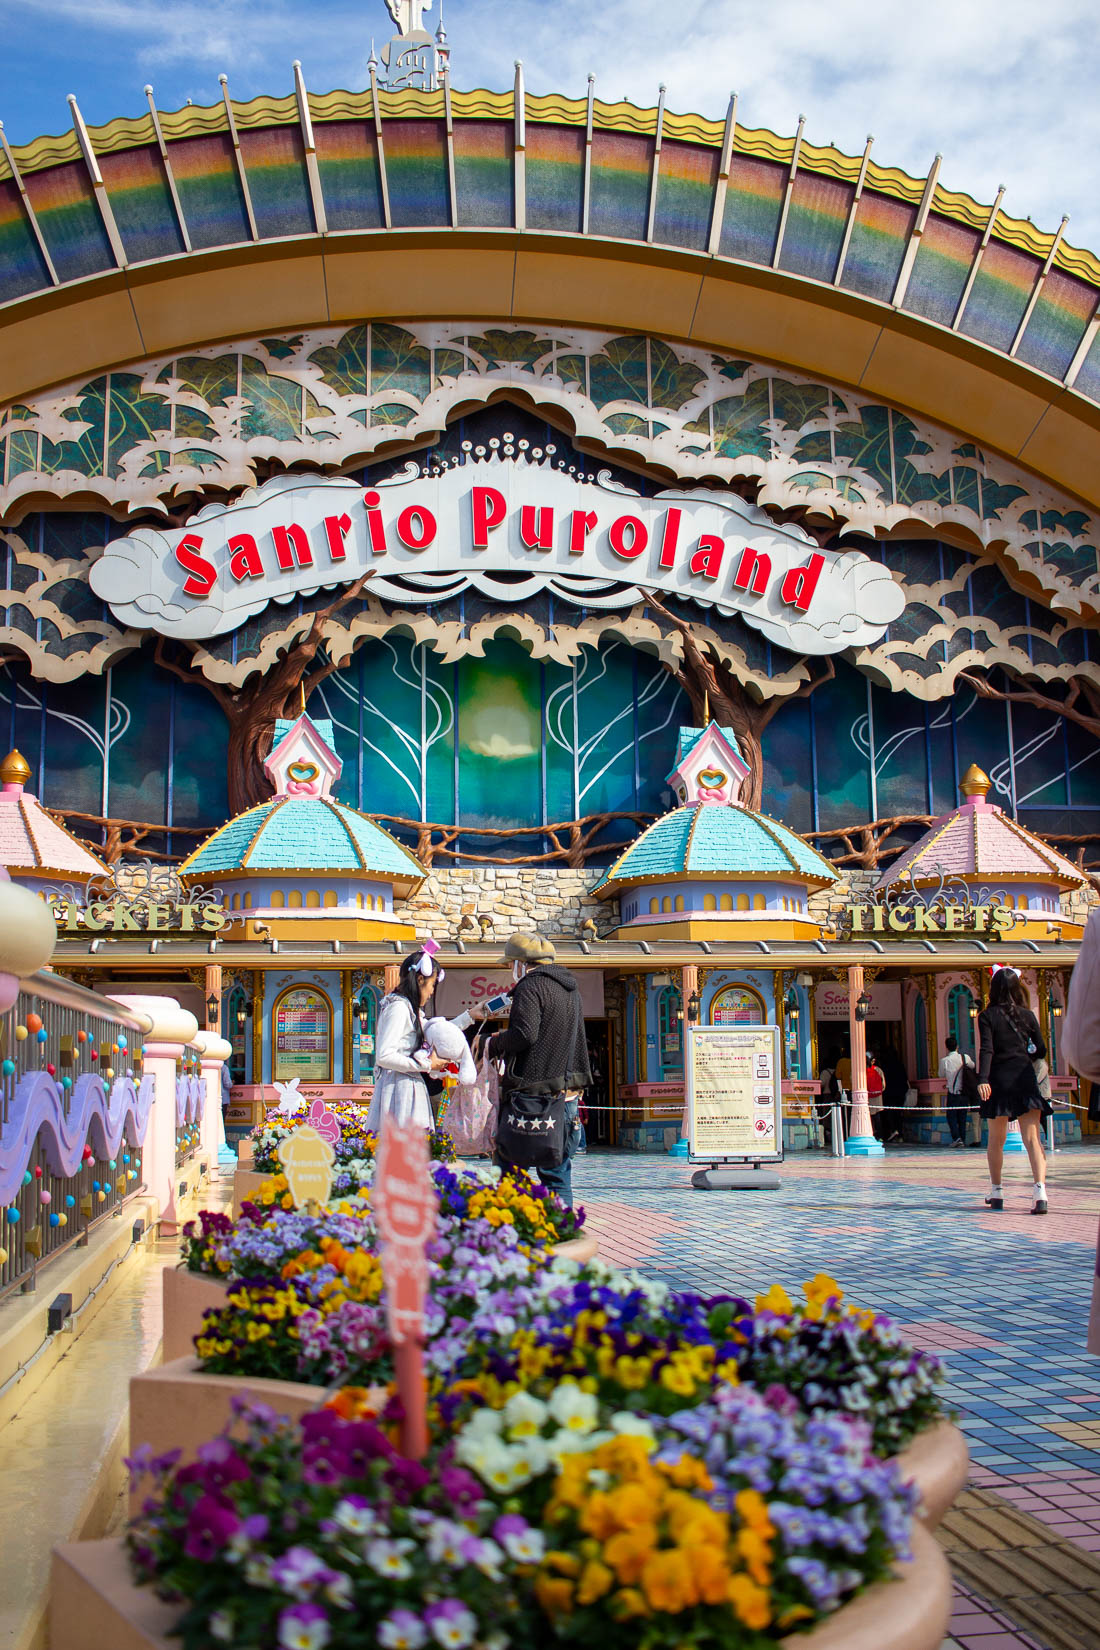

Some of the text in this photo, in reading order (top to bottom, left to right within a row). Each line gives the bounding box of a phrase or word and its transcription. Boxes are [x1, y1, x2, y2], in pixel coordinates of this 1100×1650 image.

[175, 486, 827, 612] Sanrio Puroland
[846, 905, 1015, 932] TICKETS
